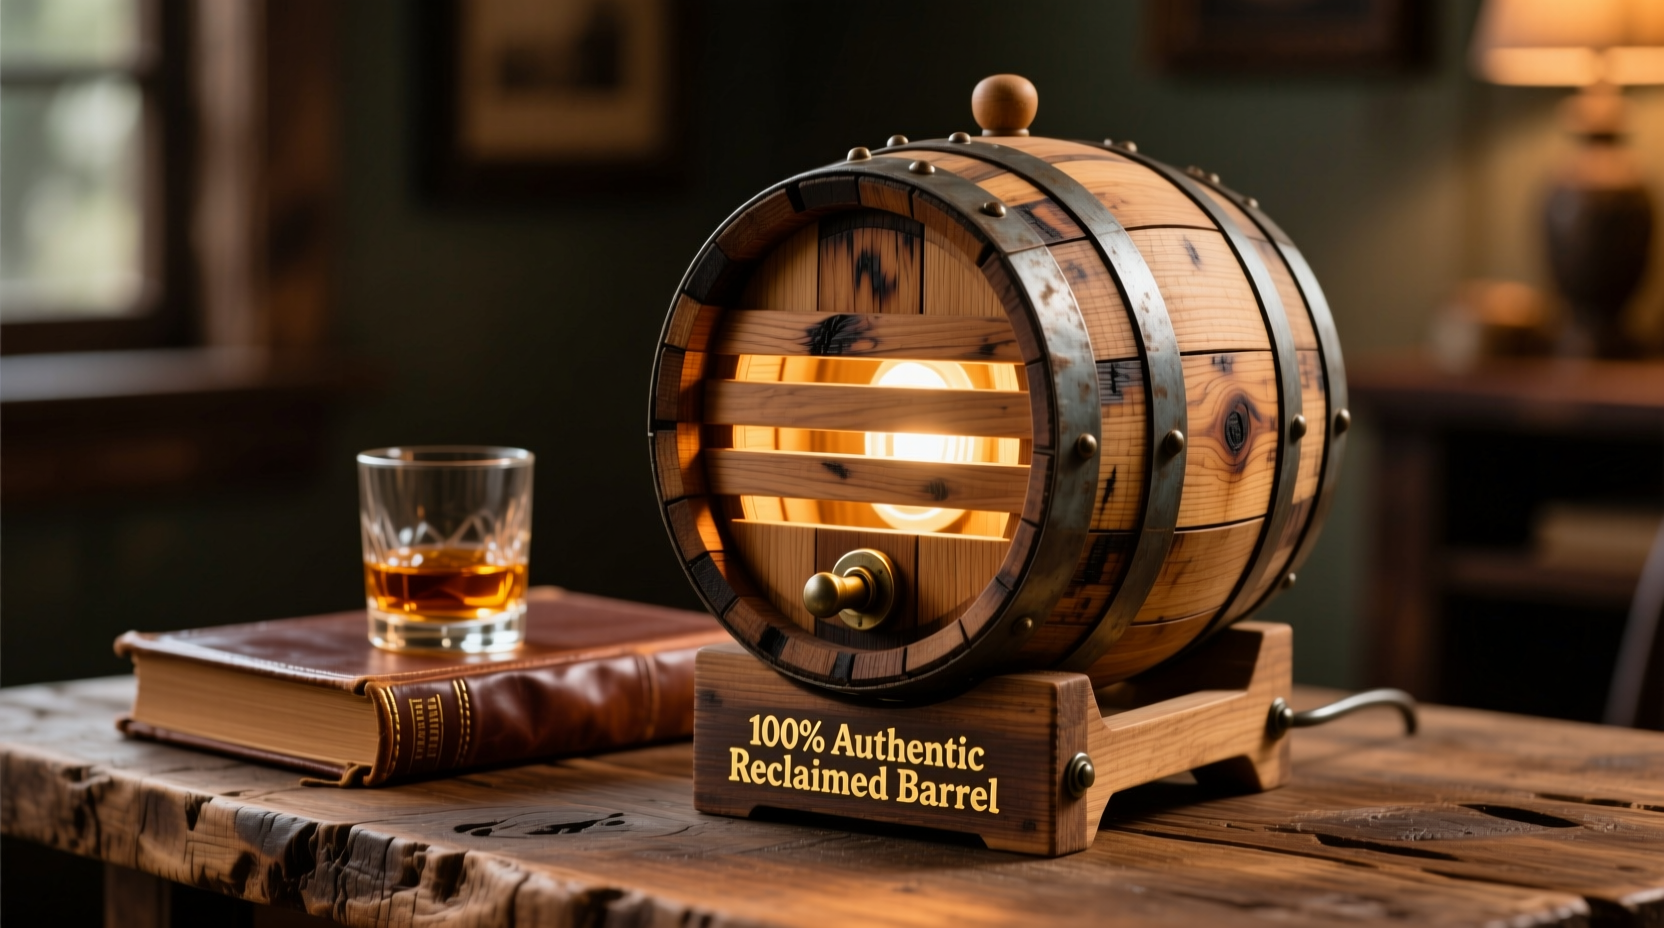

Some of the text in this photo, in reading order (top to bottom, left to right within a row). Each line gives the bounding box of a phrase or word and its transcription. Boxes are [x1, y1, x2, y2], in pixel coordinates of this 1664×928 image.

[749, 714, 985, 771] 100% Authentic
[728, 747, 1000, 814] Reclaimed Barrel
